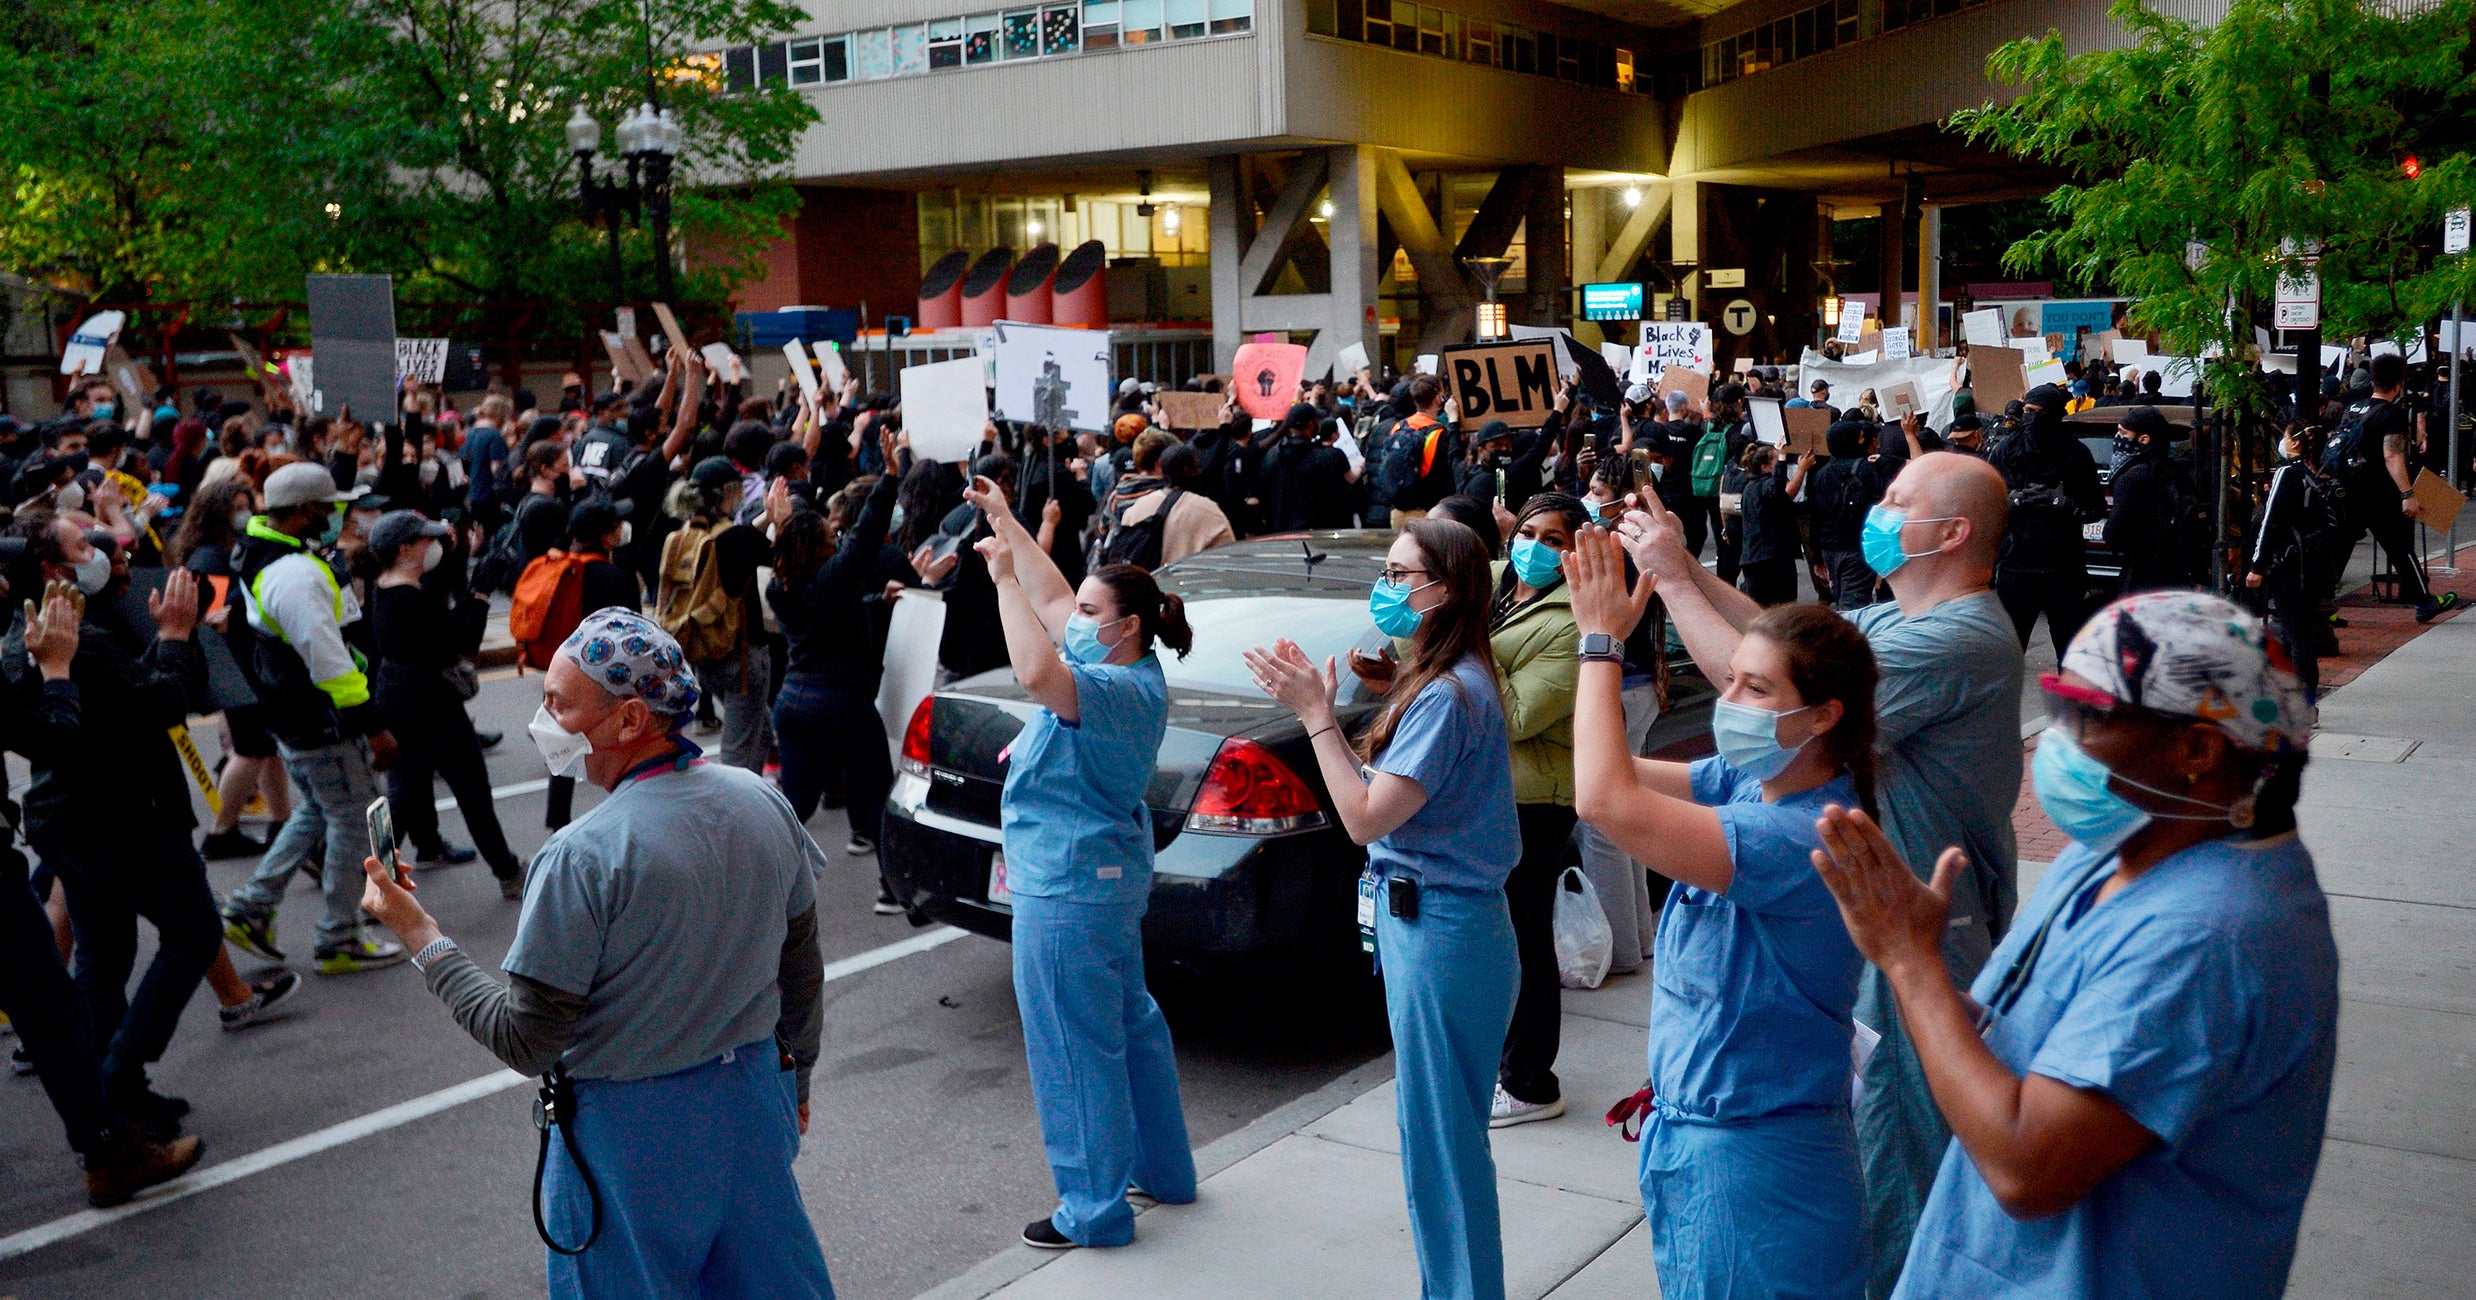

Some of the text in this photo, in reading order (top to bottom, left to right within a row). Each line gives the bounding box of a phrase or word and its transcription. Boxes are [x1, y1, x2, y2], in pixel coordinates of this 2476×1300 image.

[1729, 307, 1750, 328] T
[2046, 311, 2107, 322] YOU DON'T
[1646, 325, 1685, 342] Black
[398, 341, 442, 356] BLACK
[1657, 344, 1695, 358] Lives
[396, 358, 438, 371] LIVES
[1454, 353, 1554, 418] BLM
[177, 734, 214, 794] SHOOT
